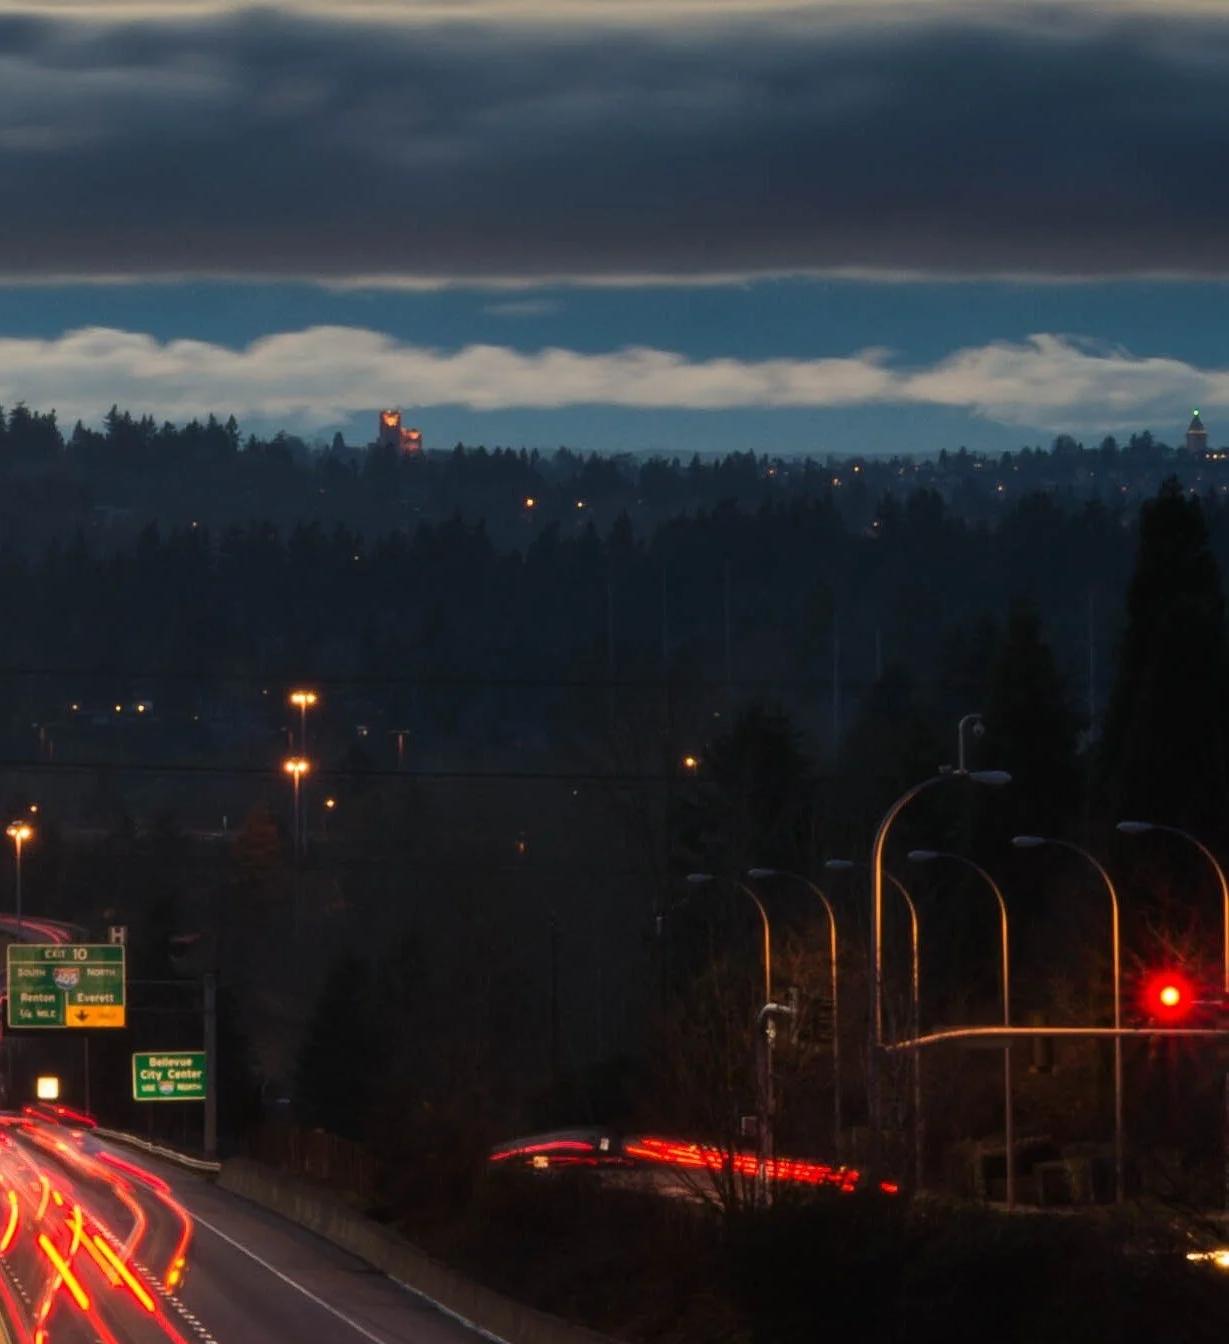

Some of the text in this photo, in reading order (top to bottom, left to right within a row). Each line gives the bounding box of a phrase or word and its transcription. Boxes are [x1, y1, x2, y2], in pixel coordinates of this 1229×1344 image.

[45, 948, 87, 960] EXIT 10
[17, 968, 46, 977] SOUTH
[86, 968, 115, 976] NORTH
[20, 992, 55, 1003] Renton
[76, 992, 114, 1003] Everett
[36, 1010, 55, 1018] MILE
[149, 1057, 192, 1067] Bellevue
[140, 1069, 202, 1080] City Center
